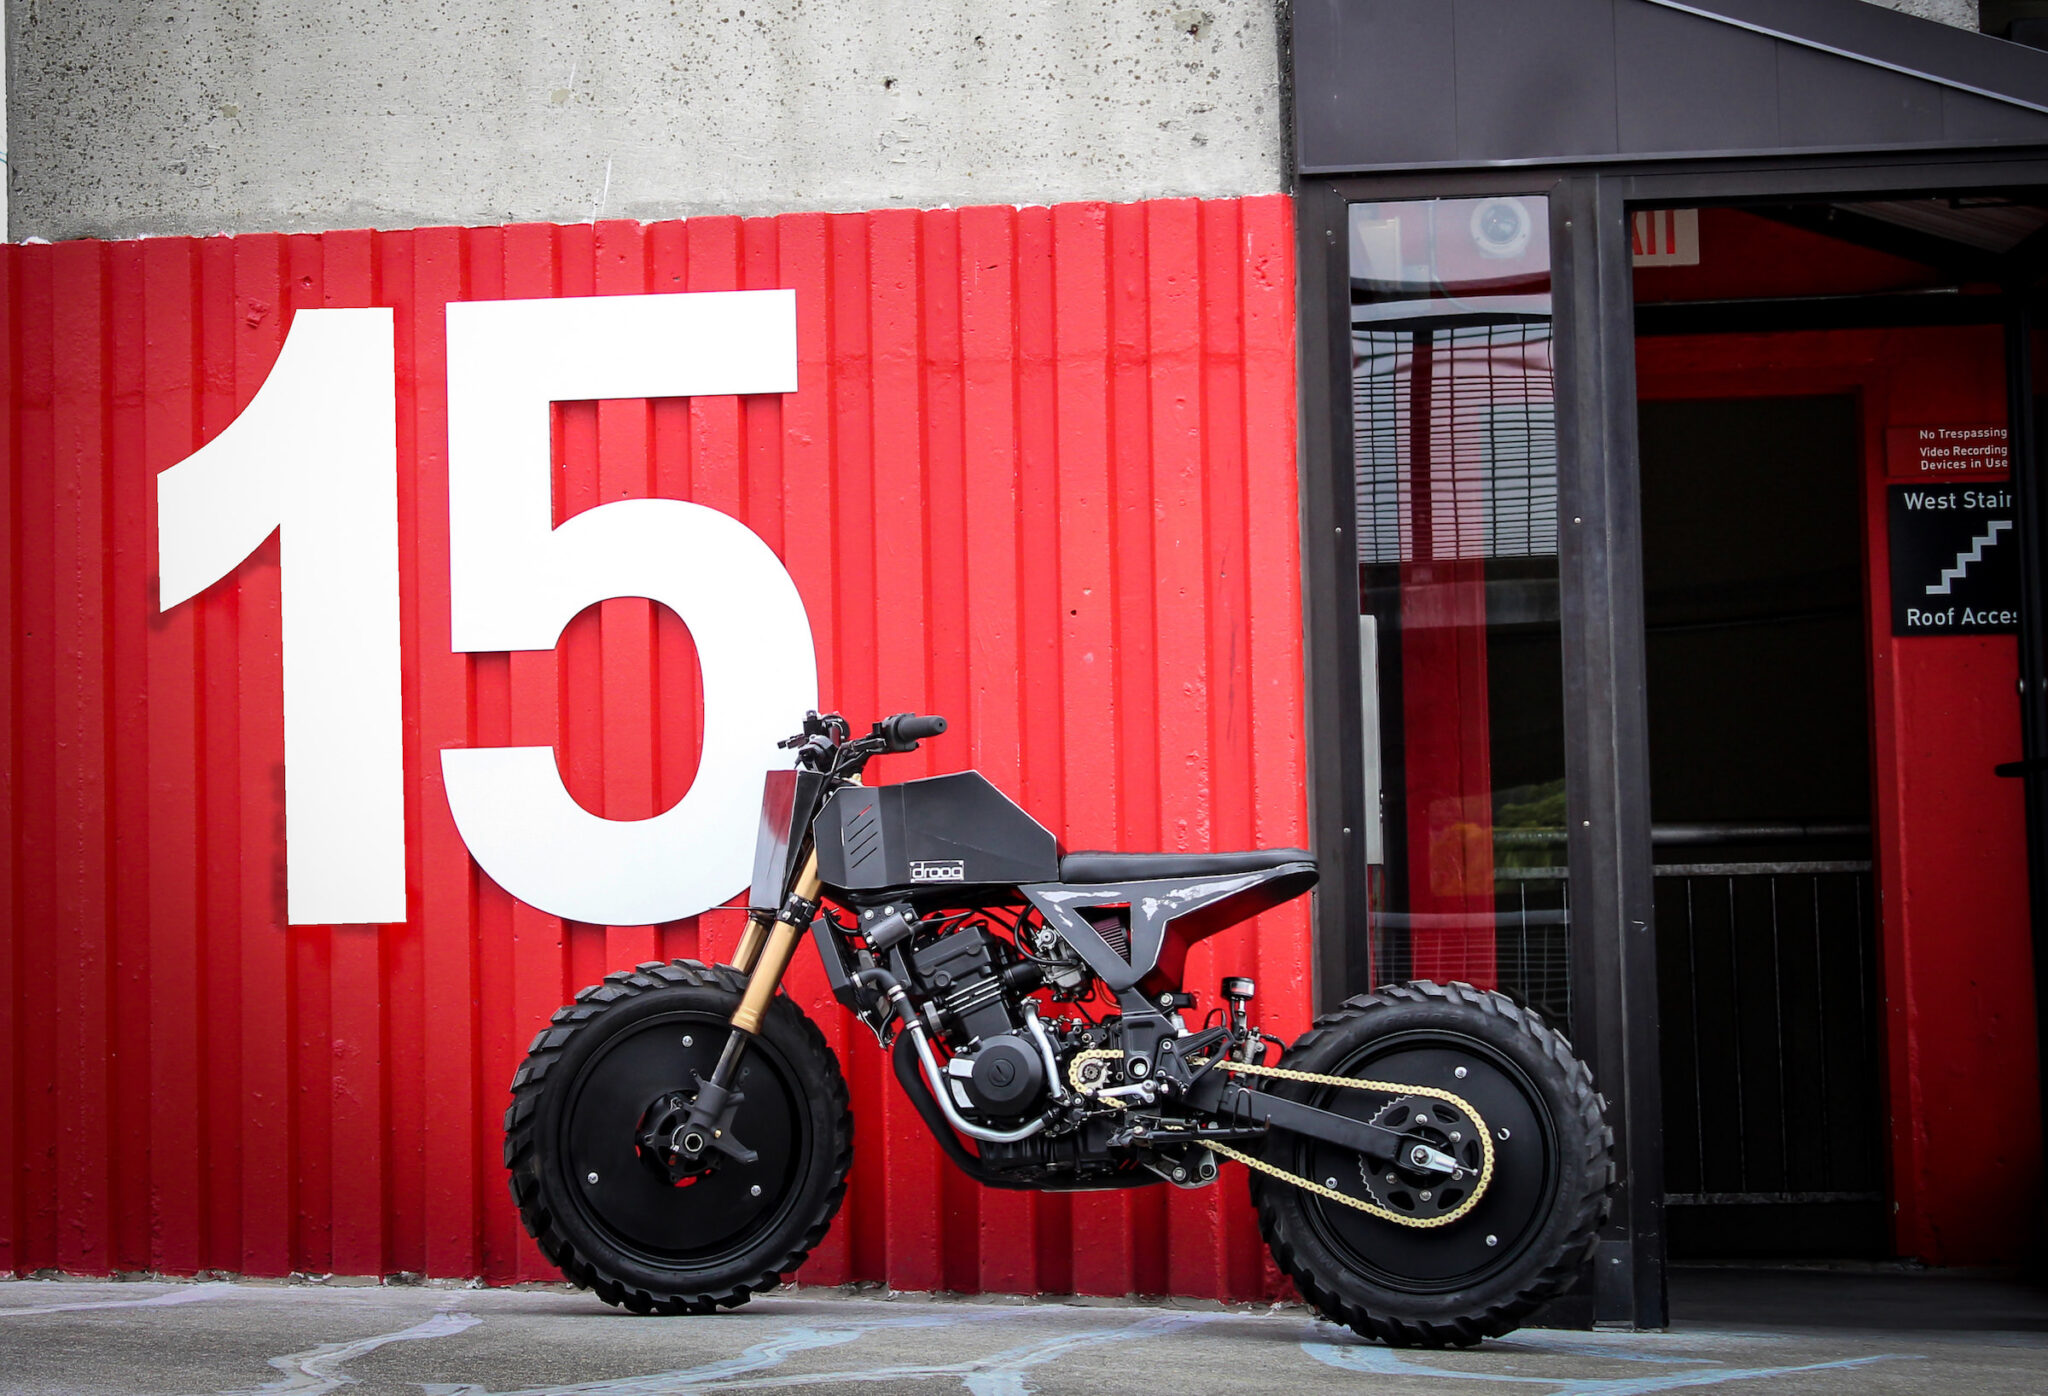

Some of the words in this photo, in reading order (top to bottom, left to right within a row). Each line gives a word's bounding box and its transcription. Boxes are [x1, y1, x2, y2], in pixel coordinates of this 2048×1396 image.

[1919, 429, 1935, 439] No
[1938, 427, 2007, 440] Trespassing
[1919, 446, 1950, 457] Video
[1953, 444, 2007, 457] Recording
[1921, 459, 1967, 470] Devices
[1970, 458, 1982, 468] in
[1985, 457, 2008, 468] Use
[1903, 492, 1956, 510] West
[1963, 490, 2011, 508] Stair
[157, 289, 818, 927] 15
[1907, 607, 1954, 626] Roof
